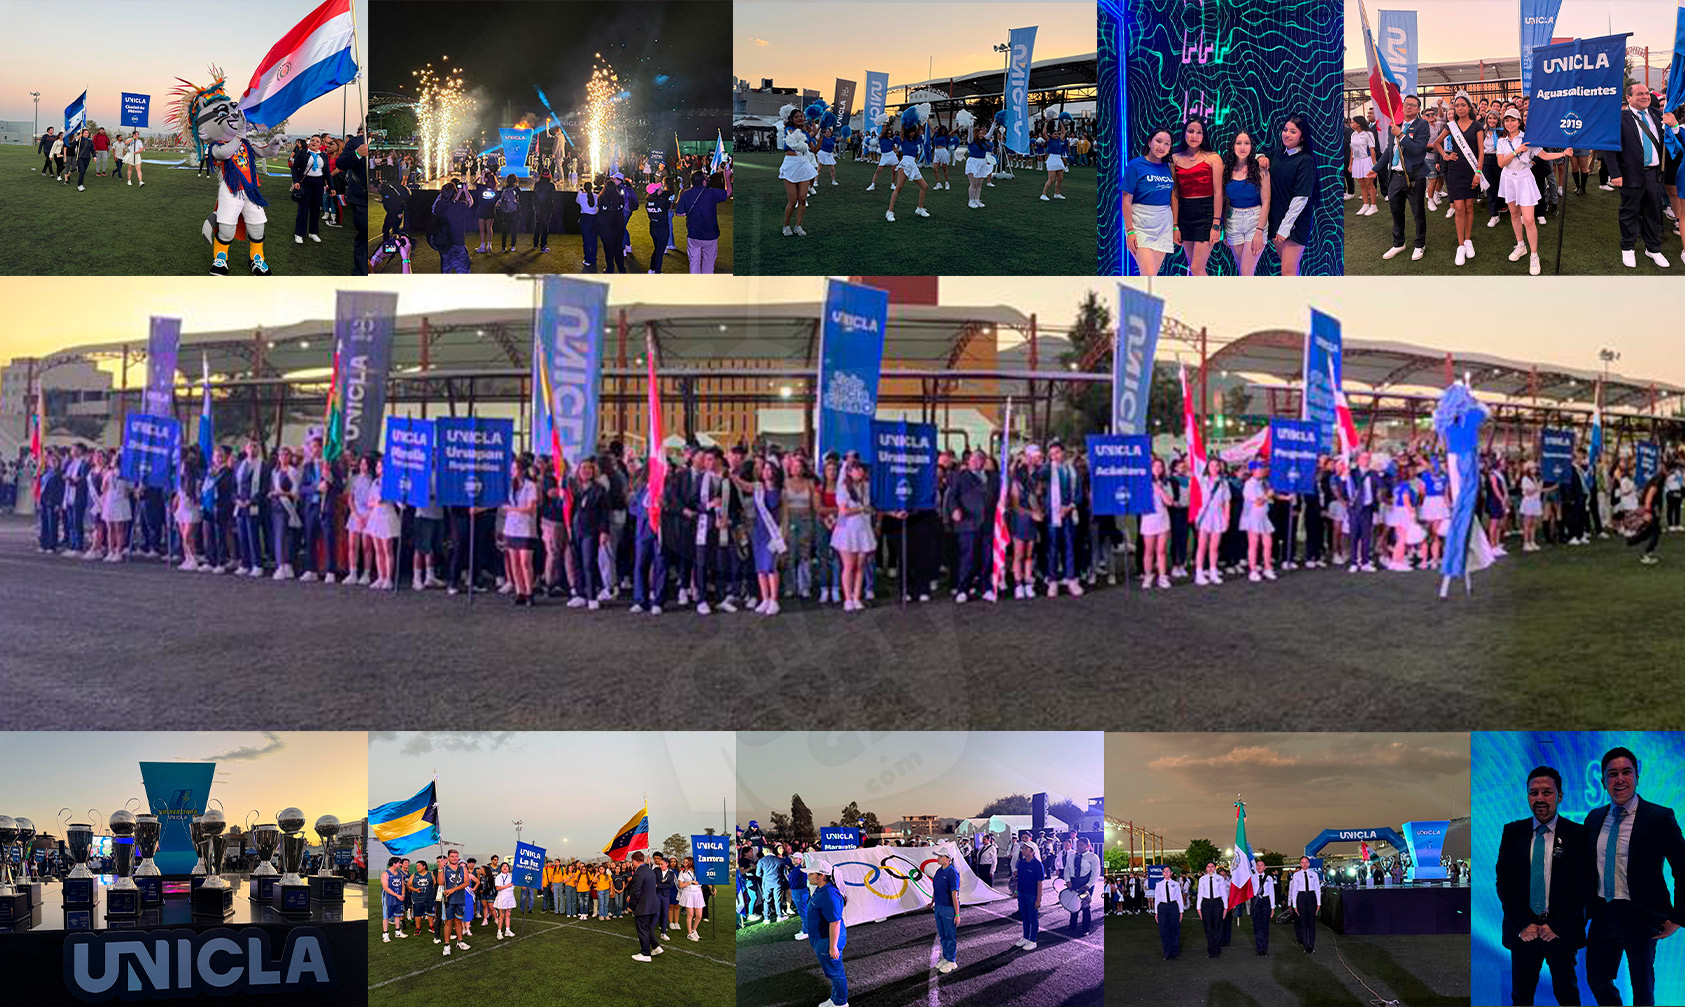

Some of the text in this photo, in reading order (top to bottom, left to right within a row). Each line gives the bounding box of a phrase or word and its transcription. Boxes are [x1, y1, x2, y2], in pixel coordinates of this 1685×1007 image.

[1525, 16, 1554, 24] UNICLA
[1543, 53, 1610, 74] UNICLA
[1537, 86, 1617, 100] Aguascalientes
[836, 100, 847, 127] UNICLA
[832, 310, 878, 332] UNICLA
[345, 355, 368, 441] UNICLA
[392, 429, 427, 446] UNICLA
[446, 429, 503, 445] UNICLA
[879, 433, 930, 448] UNICLA
[1277, 427, 1316, 443] UNICLA
[446, 446, 504, 461] Uruapan
[878, 451, 930, 465] Uruapan
[1095, 445, 1142, 456] UNICLA
[1340, 831, 1377, 839] UNICLA
[696, 842, 723, 850] UNICLA
[519, 857, 529, 866] La
[520, 848, 541, 860] UNICLA
[73, 936, 331, 994] UNICLA
